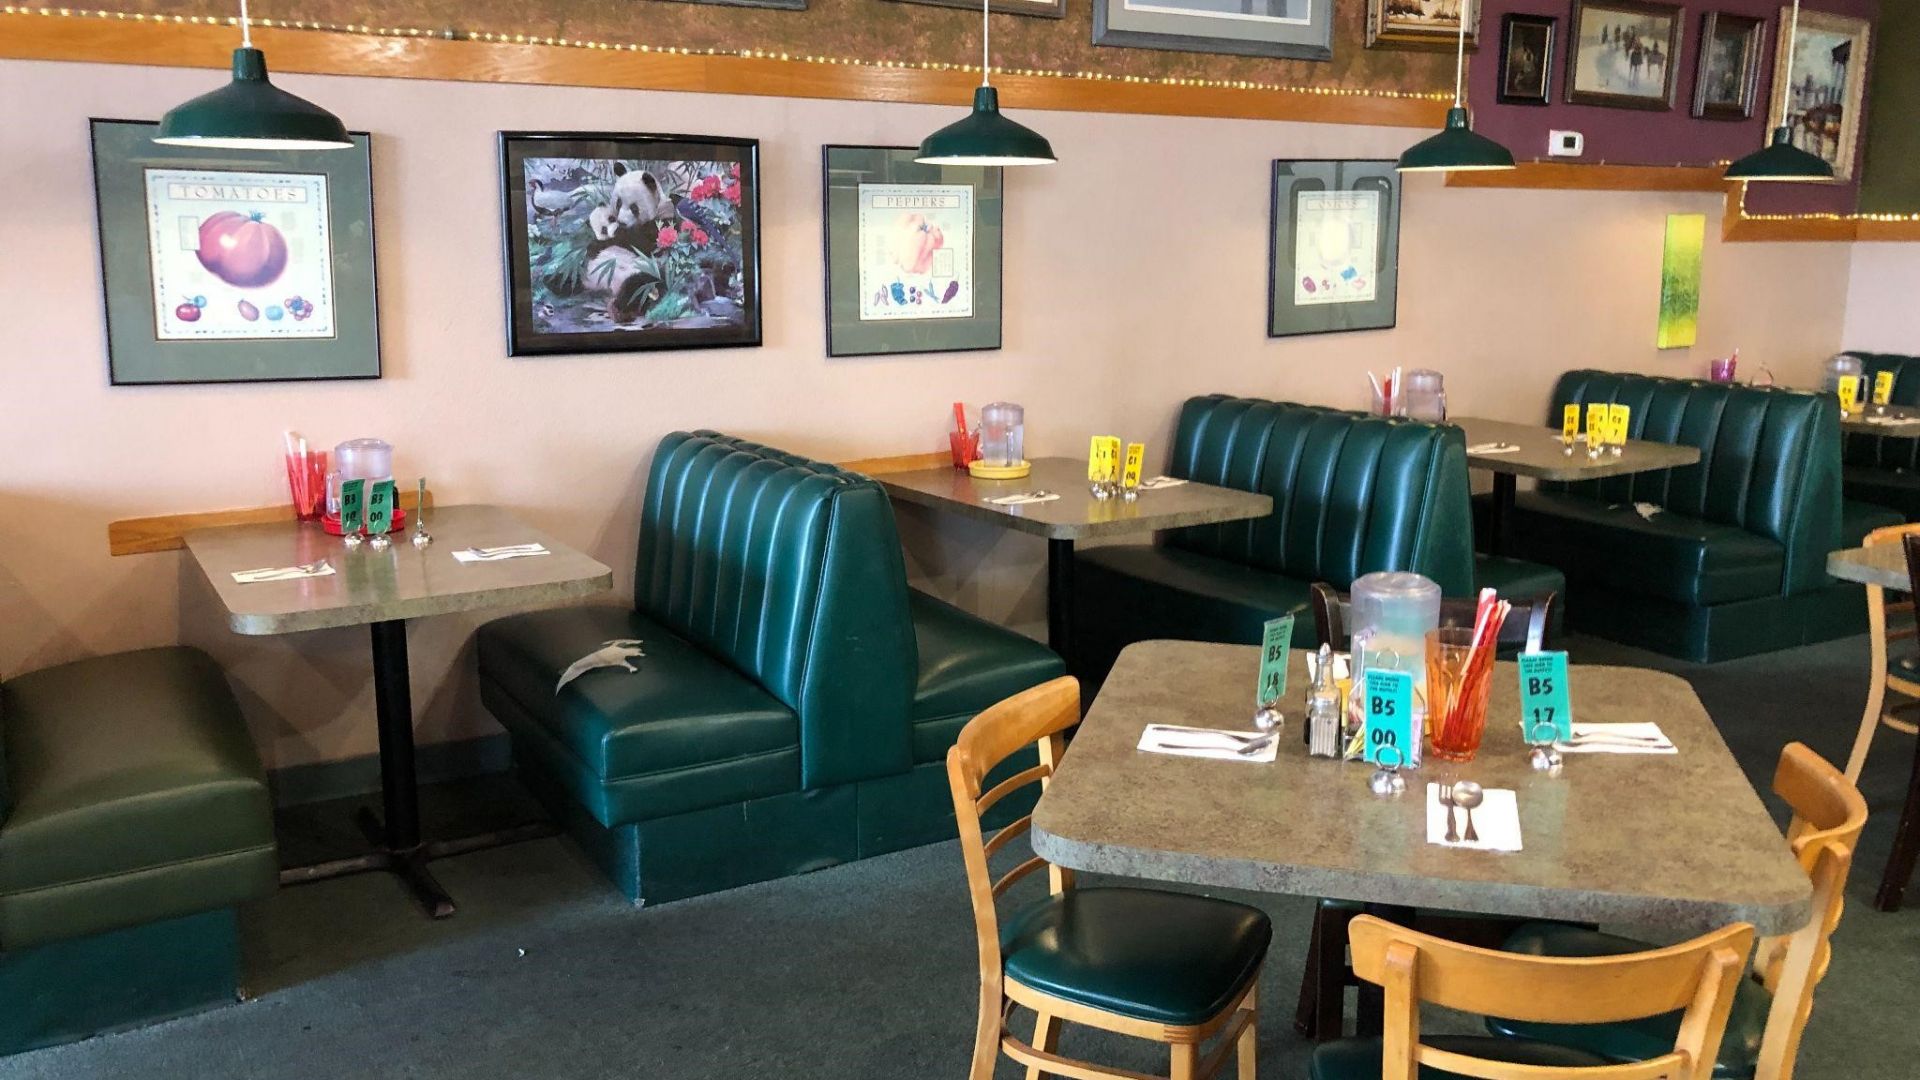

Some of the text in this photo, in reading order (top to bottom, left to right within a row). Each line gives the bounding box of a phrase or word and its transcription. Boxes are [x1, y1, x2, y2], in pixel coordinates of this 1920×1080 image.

[181, 187, 297, 199] TOMATOES
[887, 197, 945, 207] PEPPERS
[344, 494, 356, 506] B3
[371, 494, 384, 505] B3
[370, 511, 383, 522] 00
[1268, 645, 1282, 663] B5
[1267, 672, 1279, 688] 18
[1528, 677, 1553, 696] B5
[1371, 696, 1395, 716] B5
[1533, 707, 1555, 724] 17
[1371, 728, 1396, 746] 00
